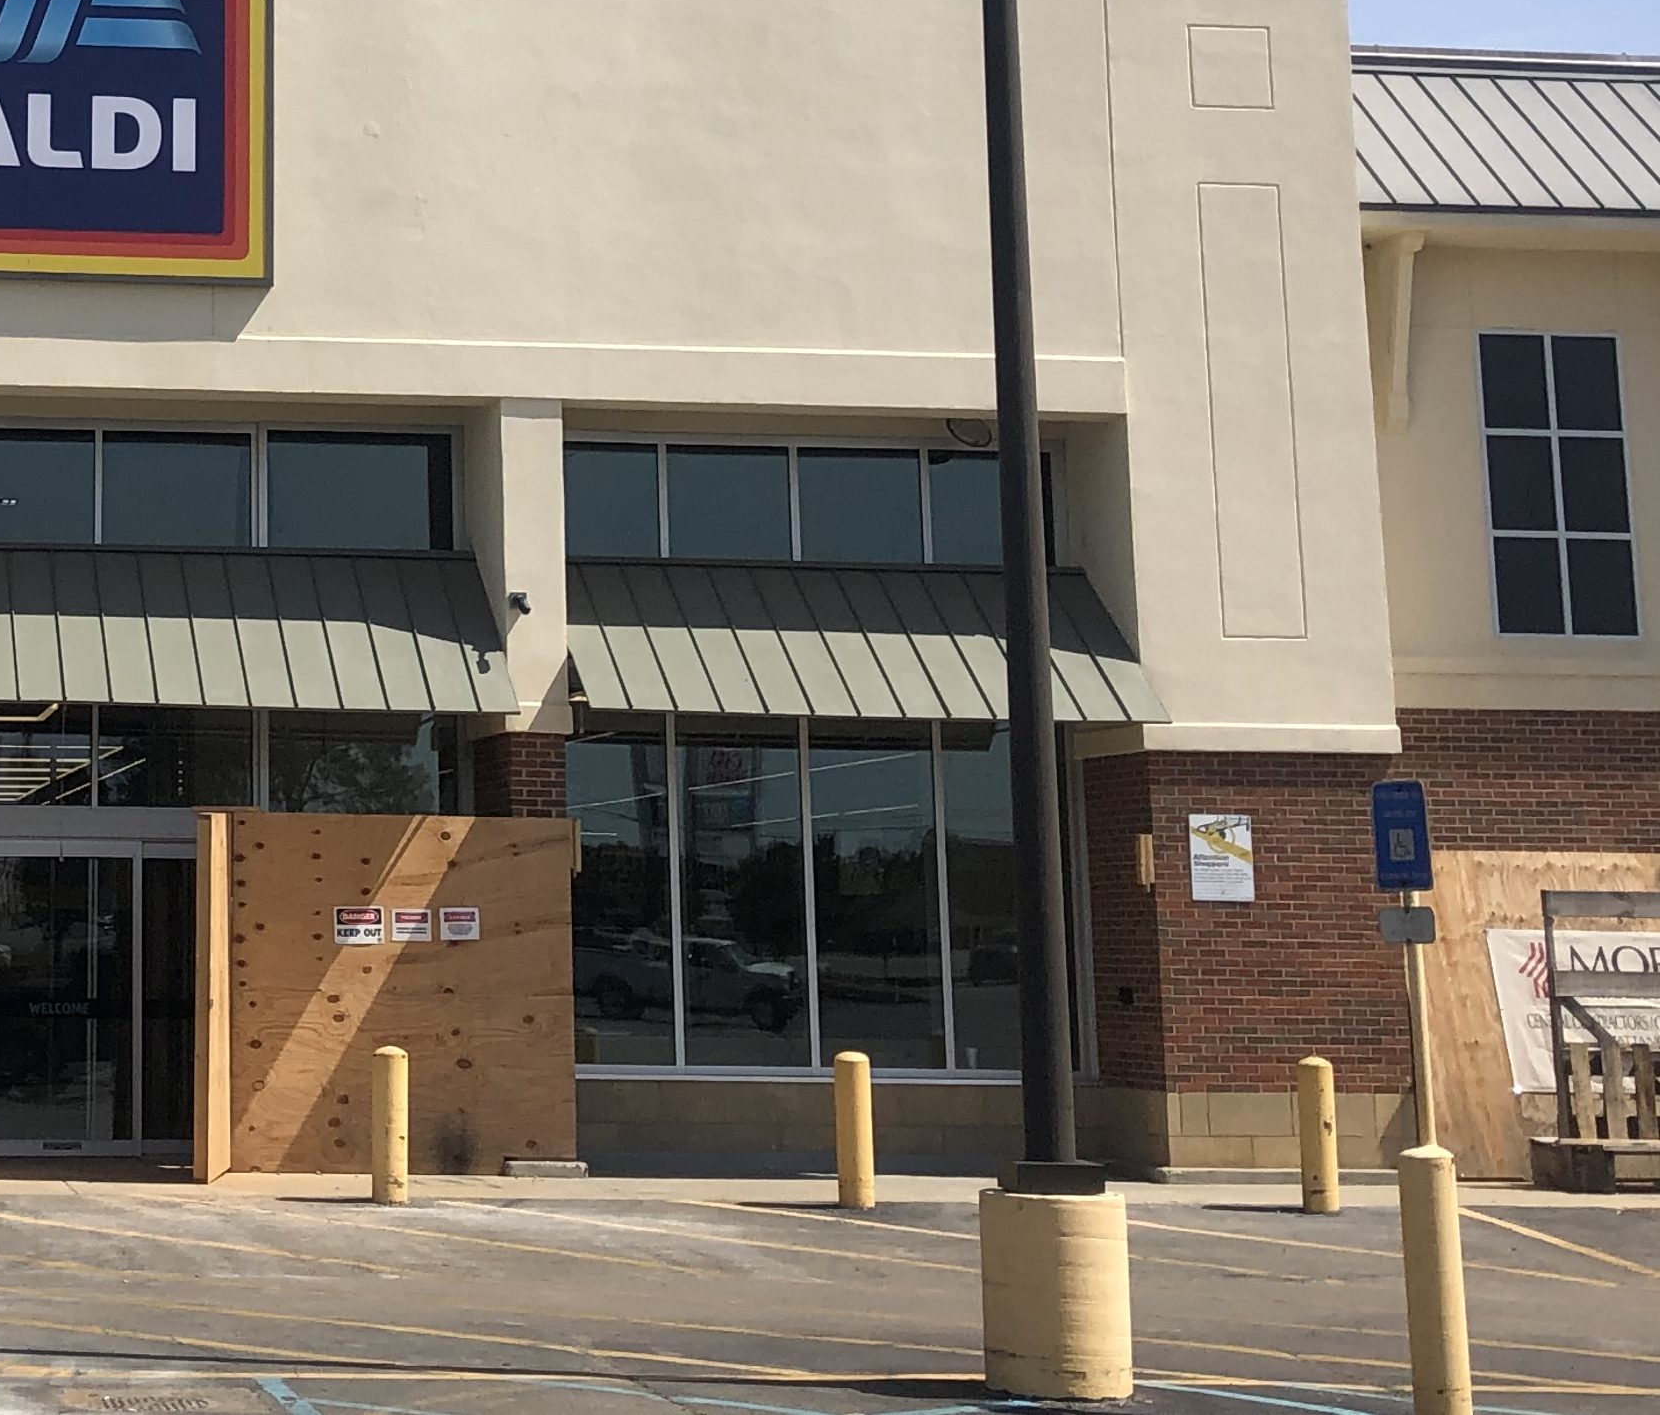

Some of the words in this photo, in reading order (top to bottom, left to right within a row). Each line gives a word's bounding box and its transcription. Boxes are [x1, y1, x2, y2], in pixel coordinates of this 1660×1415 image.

[336, 928, 361, 937] KEEP
[363, 928, 382, 937] OUT
[29, 1002, 90, 1014] WELCOME
